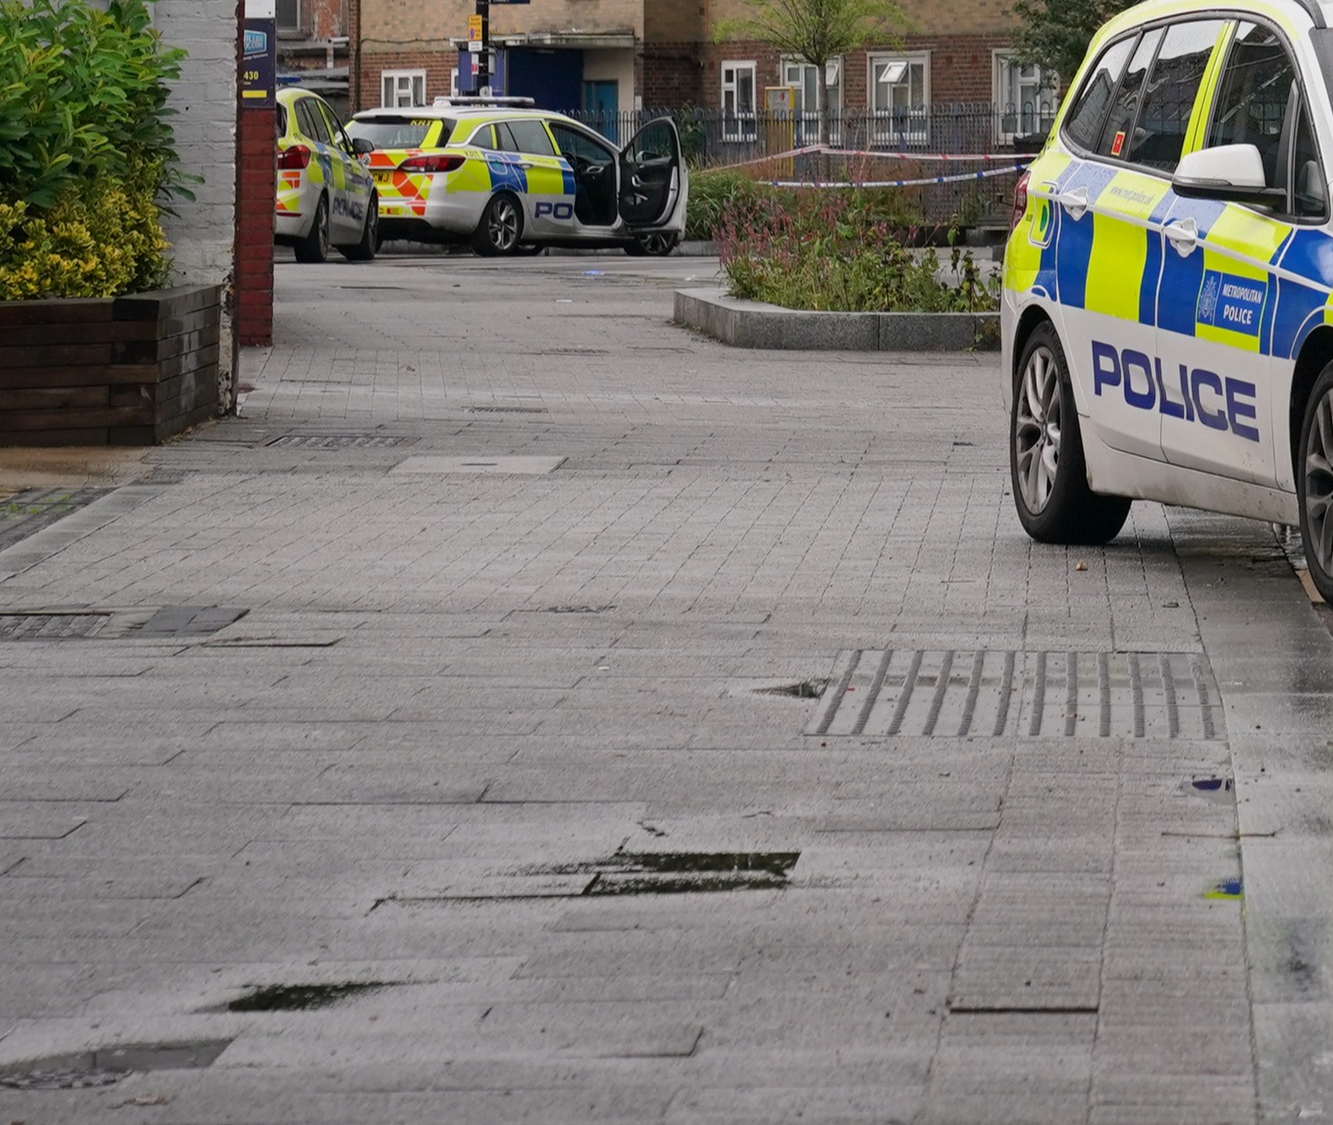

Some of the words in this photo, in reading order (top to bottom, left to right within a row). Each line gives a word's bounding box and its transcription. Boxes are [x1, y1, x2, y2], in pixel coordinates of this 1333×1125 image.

[1222, 283, 1263, 304] METROPOLITAN
[1223, 303, 1254, 324] POLICE
[1091, 340, 1260, 443] POLICE
